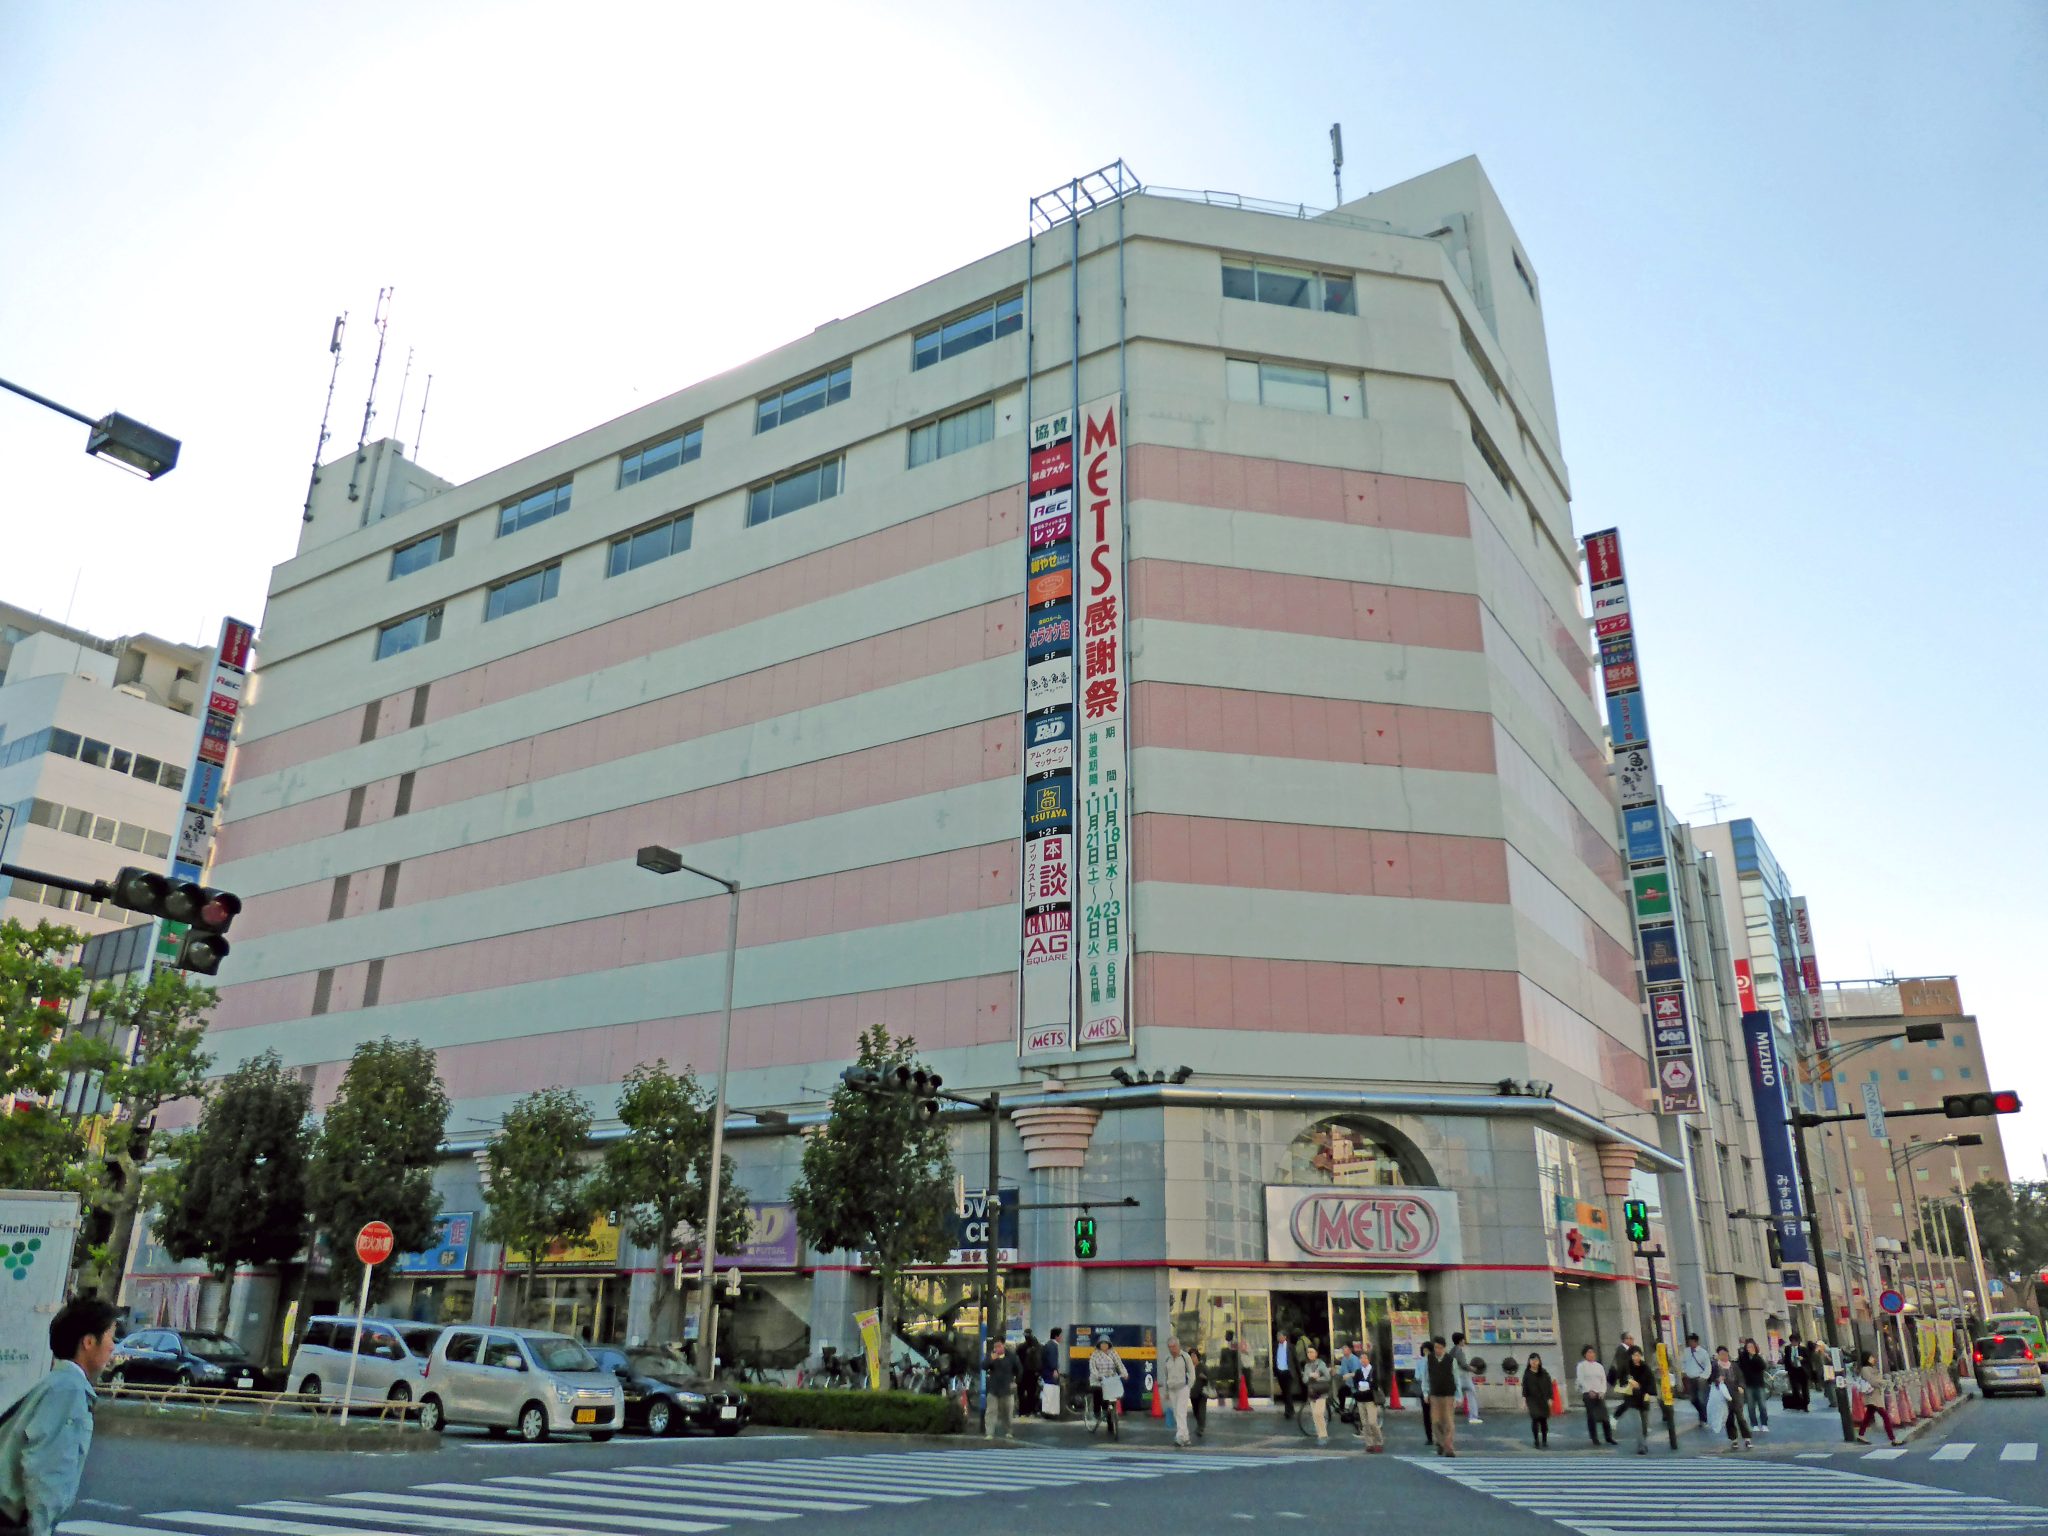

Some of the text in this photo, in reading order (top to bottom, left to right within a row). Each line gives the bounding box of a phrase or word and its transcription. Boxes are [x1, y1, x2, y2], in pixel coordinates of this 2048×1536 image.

[1034, 501, 1067, 518] REC
[1034, 522, 1067, 542] レック
[1045, 540, 1056, 549] 7F
[1044, 599, 1056, 609] 6F
[1595, 596, 1625, 609] REC
[1599, 618, 1628, 632] レック
[1029, 620, 1070, 648] カラオケ館
[1044, 652, 1056, 661] 5F
[1043, 705, 1056, 715] 4F
[1043, 769, 1055, 780] 3F
[1030, 808, 1067, 824] TSUTAYA
[1045, 841, 1061, 858] 本
[1040, 862, 1067, 897] 談
[1038, 903, 1057, 913] B1F
[1026, 911, 1070, 936] GAME!
[1027, 934, 1068, 957] AG
[1026, 953, 1068, 966] SQUARE
[1088, 1018, 1117, 1038] METS
[1032, 1032, 1064, 1048] METS
[1756, 1031, 1775, 1086] MIZUHO
[1664, 1095, 1698, 1111] ゲーム
[1315, 1200, 1421, 1251] METS
[359, 1235, 392, 1251] 防火水槽
